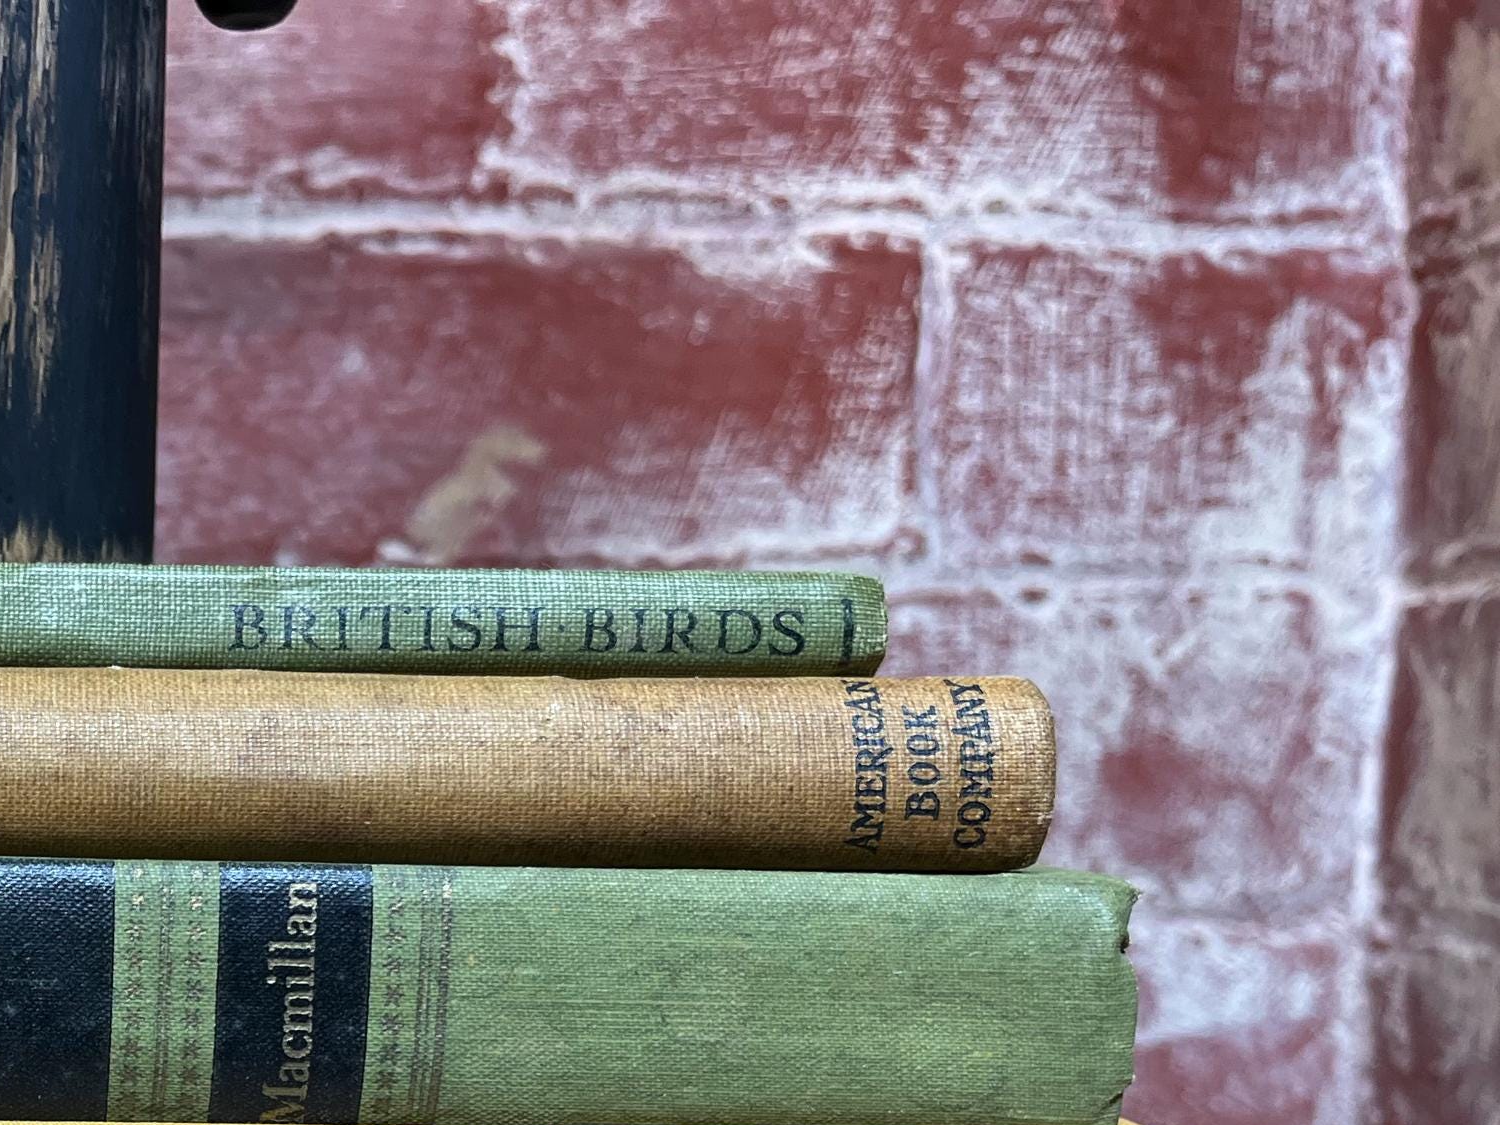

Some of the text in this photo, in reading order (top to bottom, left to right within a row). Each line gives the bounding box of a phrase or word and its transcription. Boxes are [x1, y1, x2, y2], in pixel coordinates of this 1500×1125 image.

[228, 602, 807, 659] BRITISH BIRDS
[841, 679, 894, 854] AMERICAN
[901, 705, 941, 821] BOOK
[943, 679, 995, 849] COMPANY
[259, 882, 318, 1123] Macmillan
